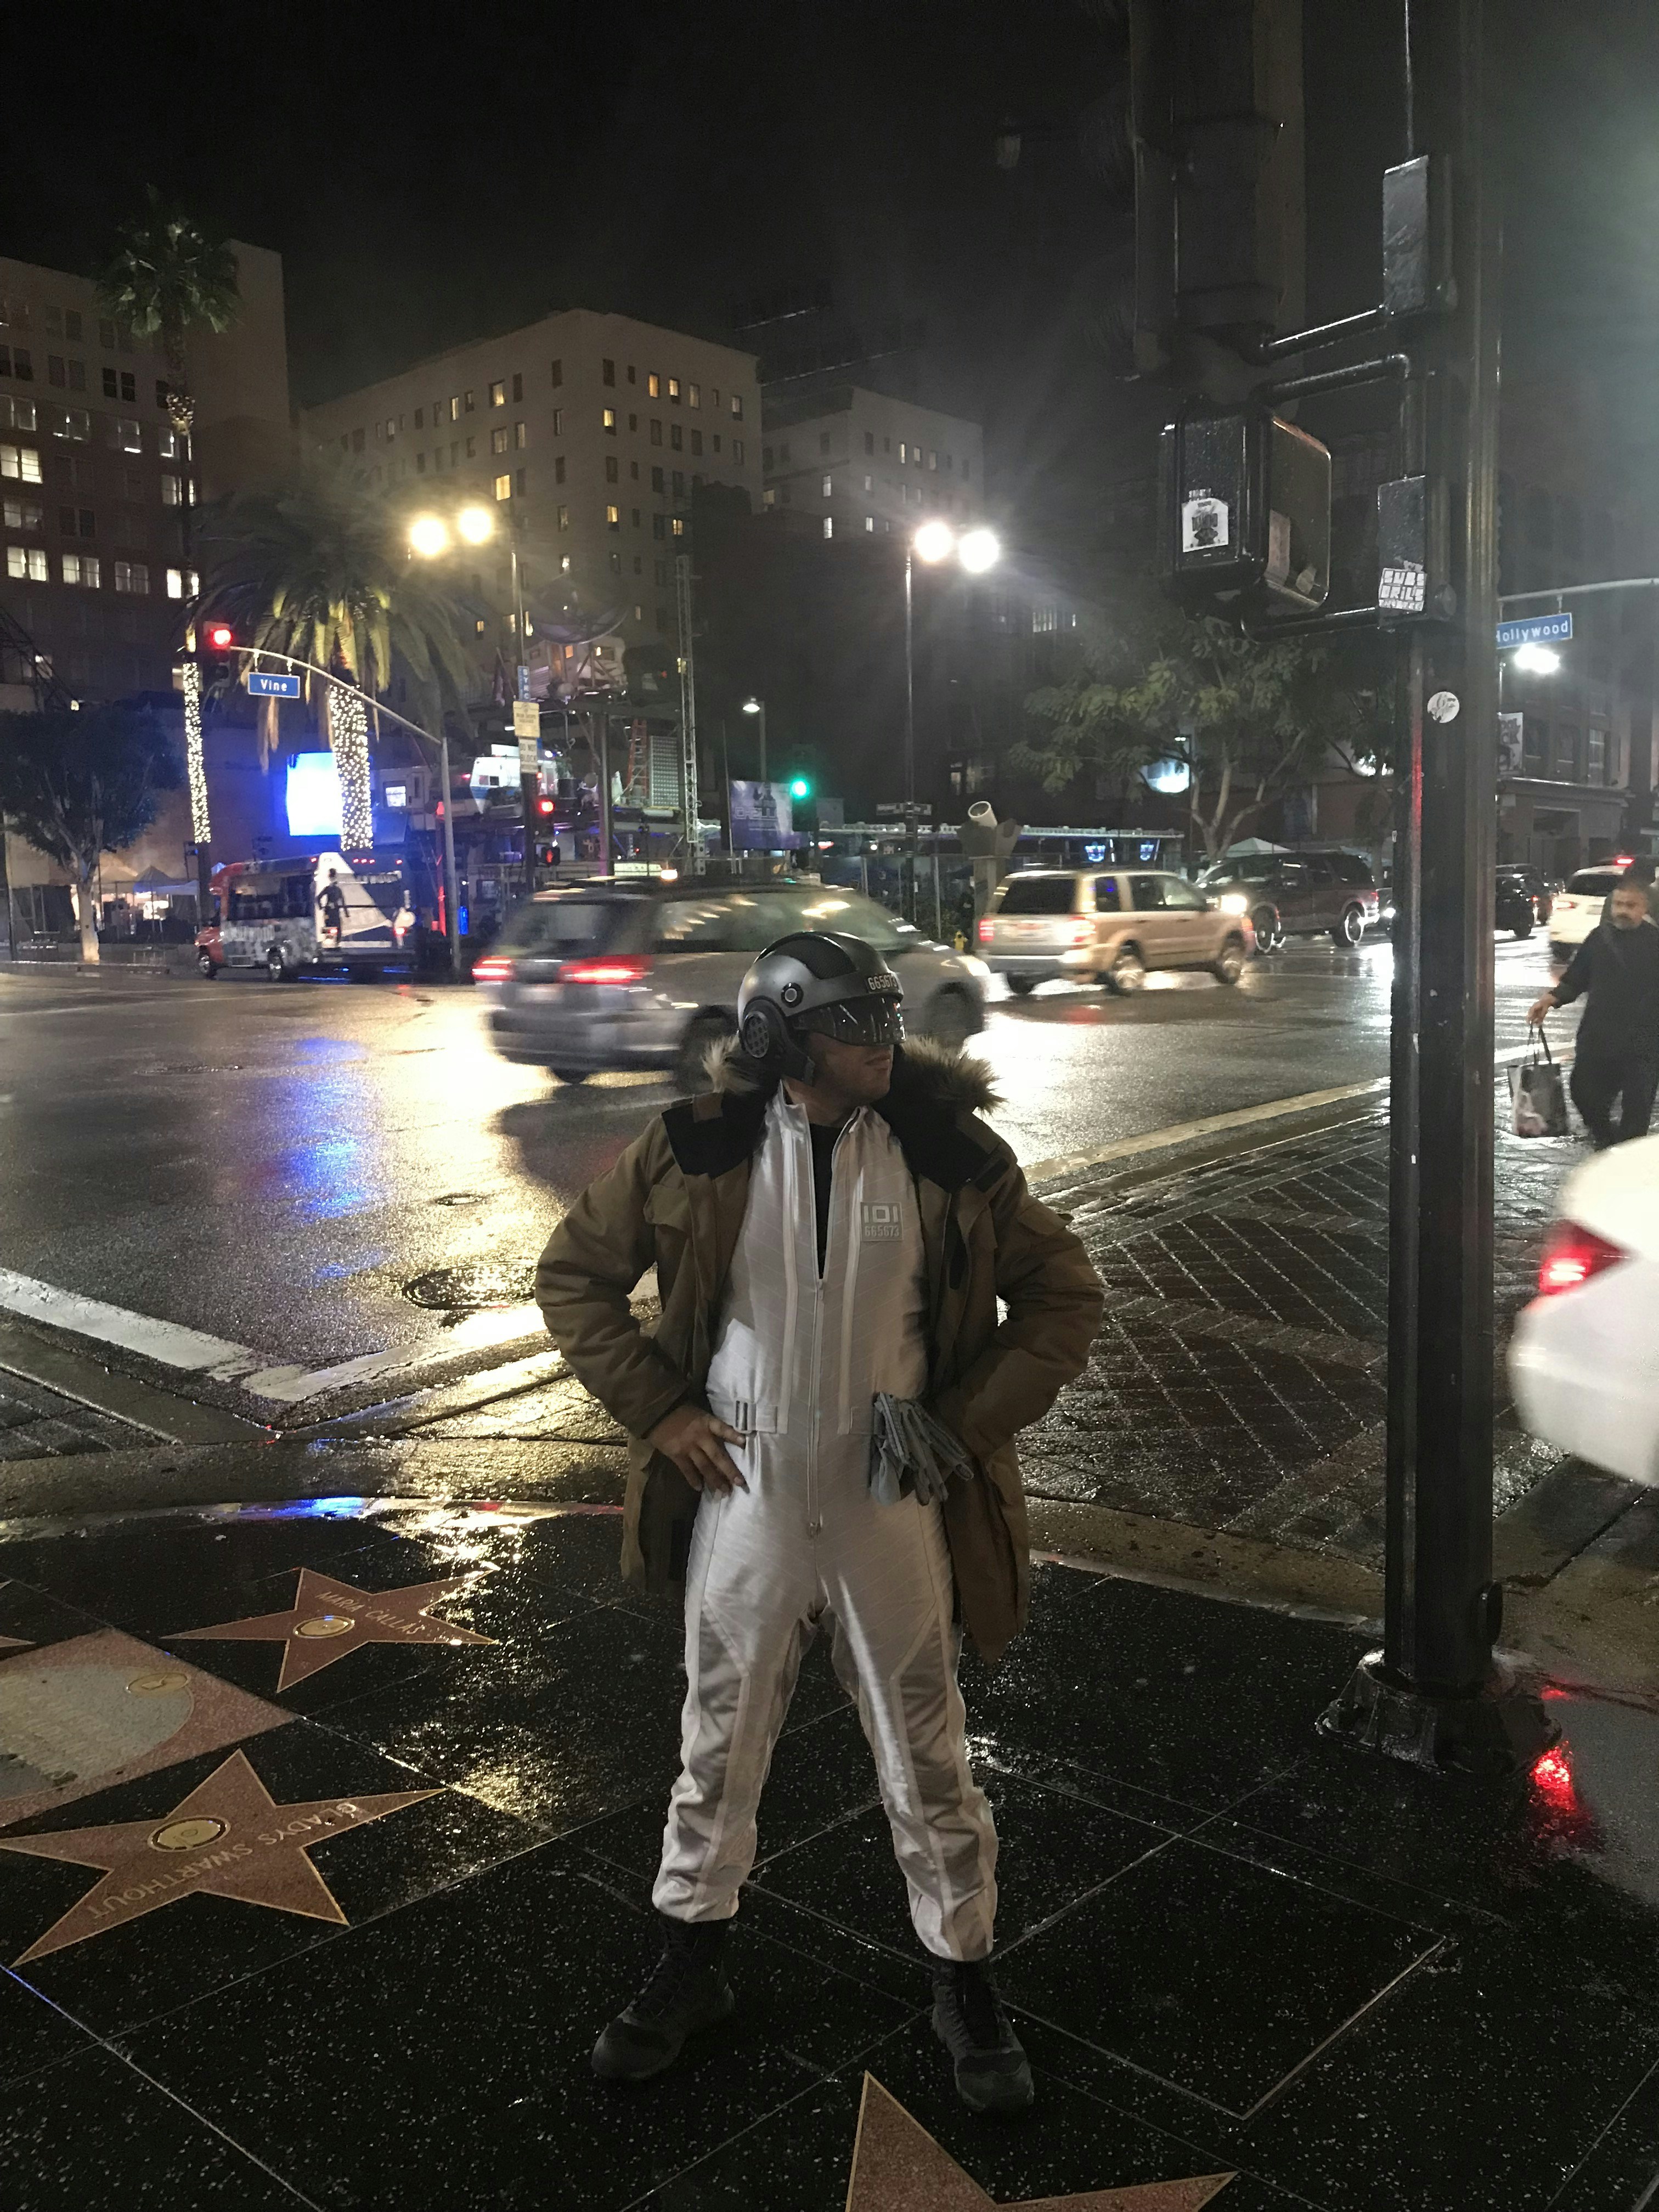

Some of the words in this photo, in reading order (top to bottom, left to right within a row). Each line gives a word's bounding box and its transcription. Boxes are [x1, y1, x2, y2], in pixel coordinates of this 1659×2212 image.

[261, 679, 287, 692] Vine
[865, 1225, 899, 1237] 665673
[314, 1591, 365, 1612] MARIA
[365, 1610, 425, 1635] CALLAS
[257, 1802, 357, 1846] GLADYS
[87, 1843, 253, 1919] SWARTHOUT
